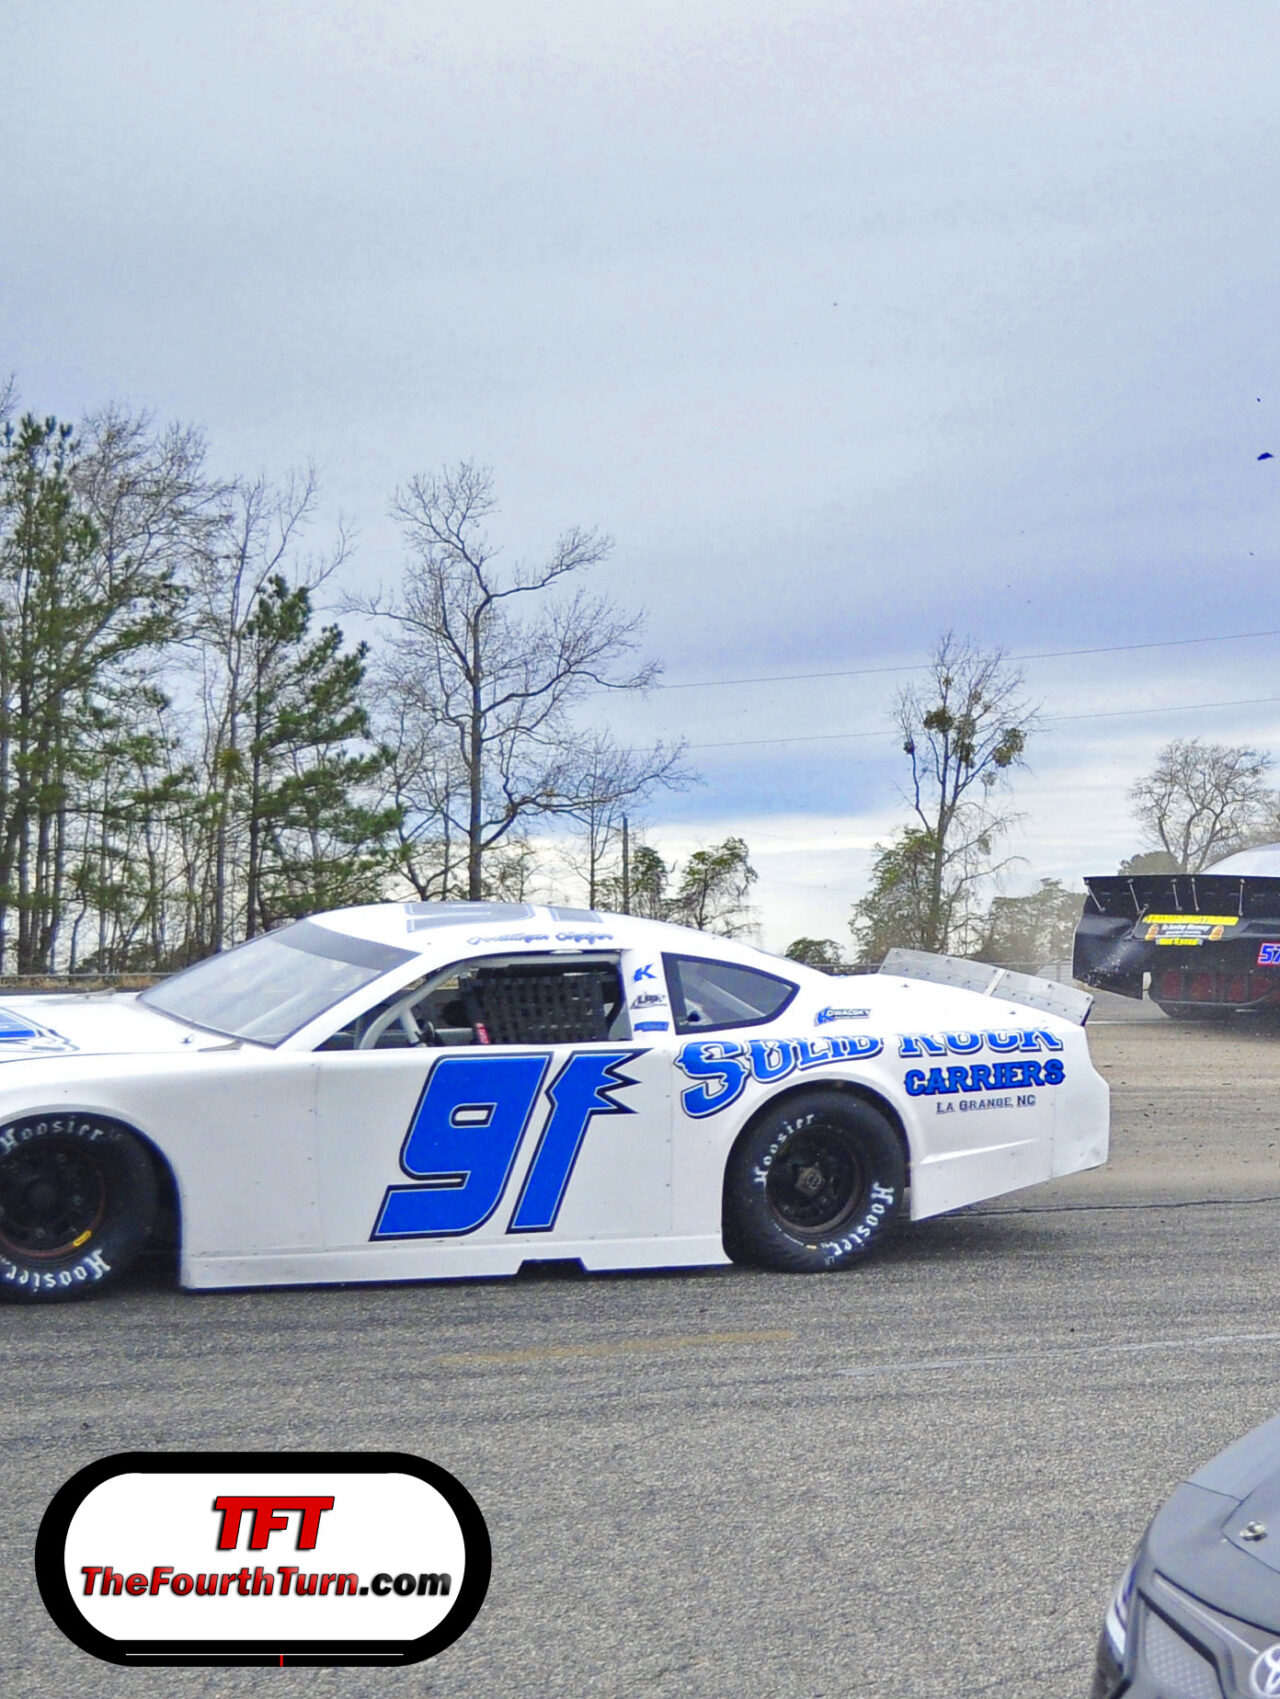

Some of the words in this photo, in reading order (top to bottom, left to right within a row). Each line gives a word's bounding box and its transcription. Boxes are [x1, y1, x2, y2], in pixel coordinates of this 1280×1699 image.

[904, 1058, 1066, 1097] CARRIERS
[935, 1101, 955, 1115] LA
[1016, 1094, 1037, 1108] NC
[0, 1115, 104, 1155] Hoosier
[754, 1113, 815, 1188] Hoosier
[834, 1181, 895, 1257] Hoosier
[5, 1249, 112, 1293] Hoosier
